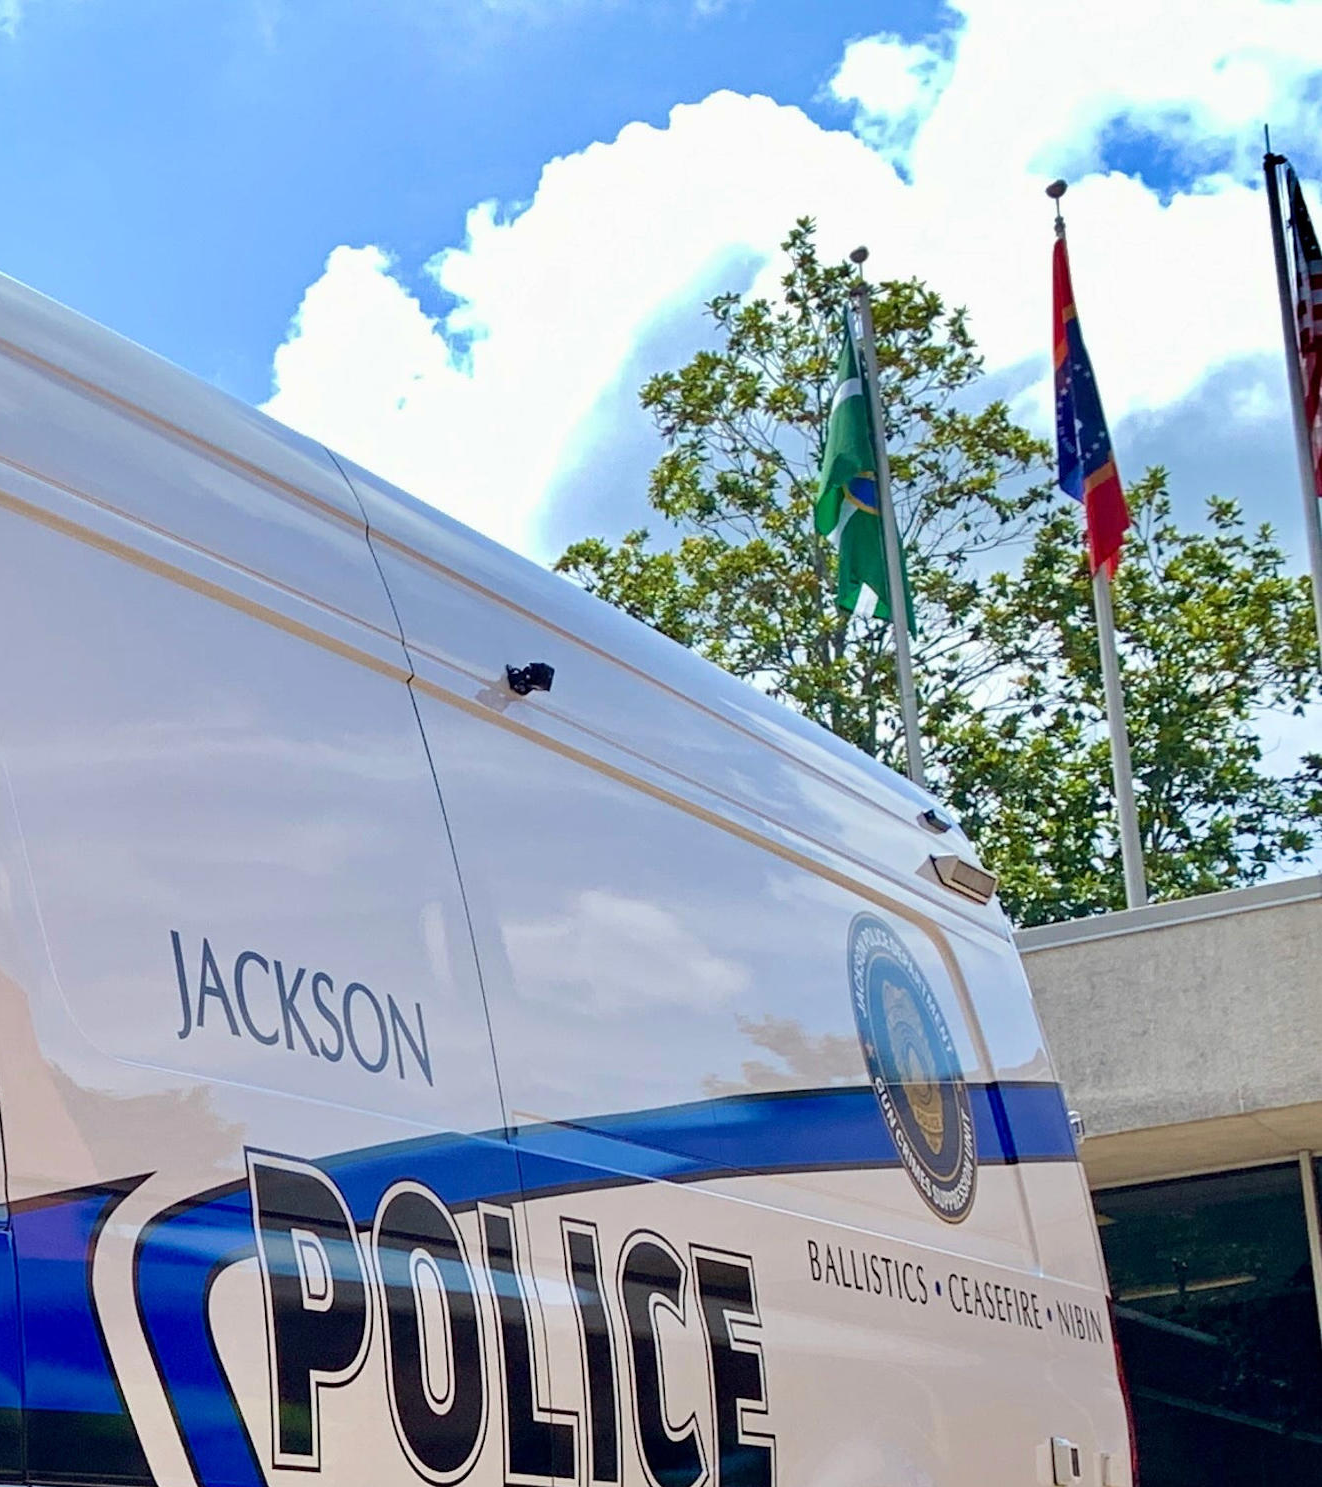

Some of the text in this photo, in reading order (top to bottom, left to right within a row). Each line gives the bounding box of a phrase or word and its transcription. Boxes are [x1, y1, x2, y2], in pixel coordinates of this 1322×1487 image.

[168, 929, 435, 1087] JACKSON
[875, 1077, 897, 1128] GUN
[895, 1129, 932, 1198] CRIMES
[961, 1108, 975, 1160] UNIT
[807, 1239, 1104, 1344] BALLISTICS CEASEFIRE NIBIN
